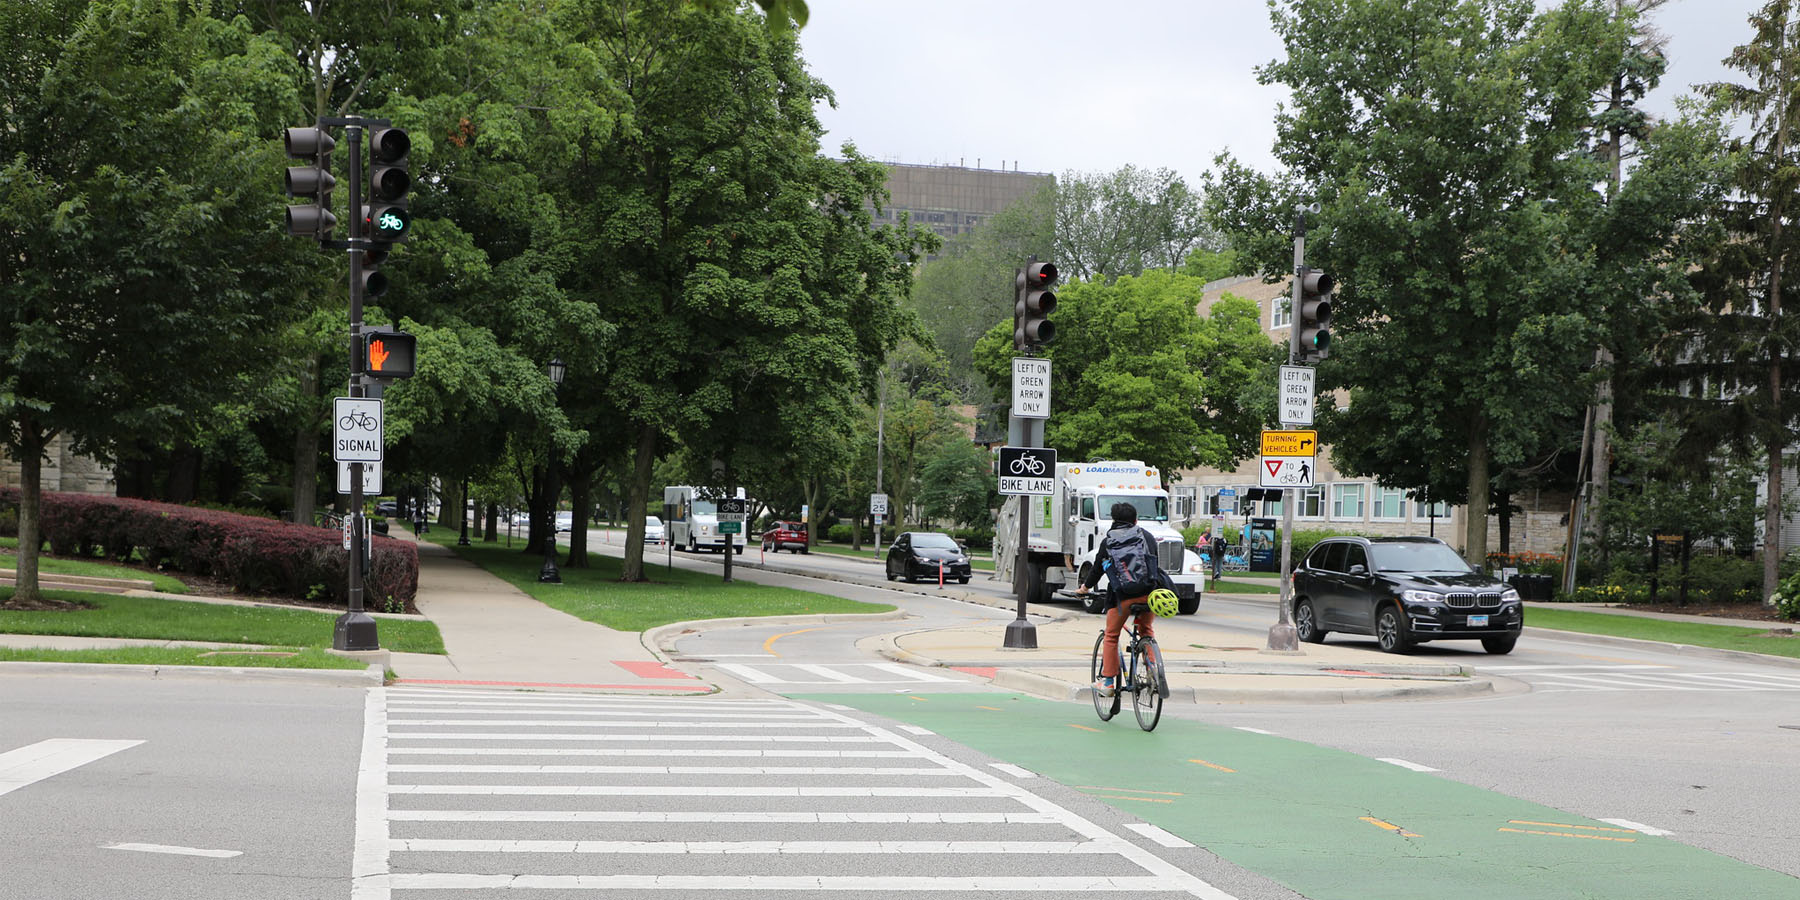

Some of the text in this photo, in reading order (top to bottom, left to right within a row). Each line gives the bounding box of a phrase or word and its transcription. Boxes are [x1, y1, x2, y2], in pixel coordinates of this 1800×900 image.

[1017, 363, 1047, 374] LEFT ON
[1020, 376, 1044, 387] GREEN
[1283, 371, 1312, 382] LEFT ON
[1286, 384, 1308, 394] GREEN
[1019, 389, 1045, 400] ARROW
[1022, 402, 1041, 412] ONLY
[1285, 397, 1308, 407] ARROW
[1287, 409, 1305, 419] ONLY
[1266, 435, 1298, 443] TURNING
[338, 439, 379, 451] SIGNAL
[1264, 445, 1298, 453] VEHICLES
[346, 462, 375, 473] AOW
[1285, 462, 1295, 470] TO
[1001, 479, 1053, 492] BIKE LANE
[872, 504, 886, 512] 25
[717, 513, 744, 521] BIKE LANE
